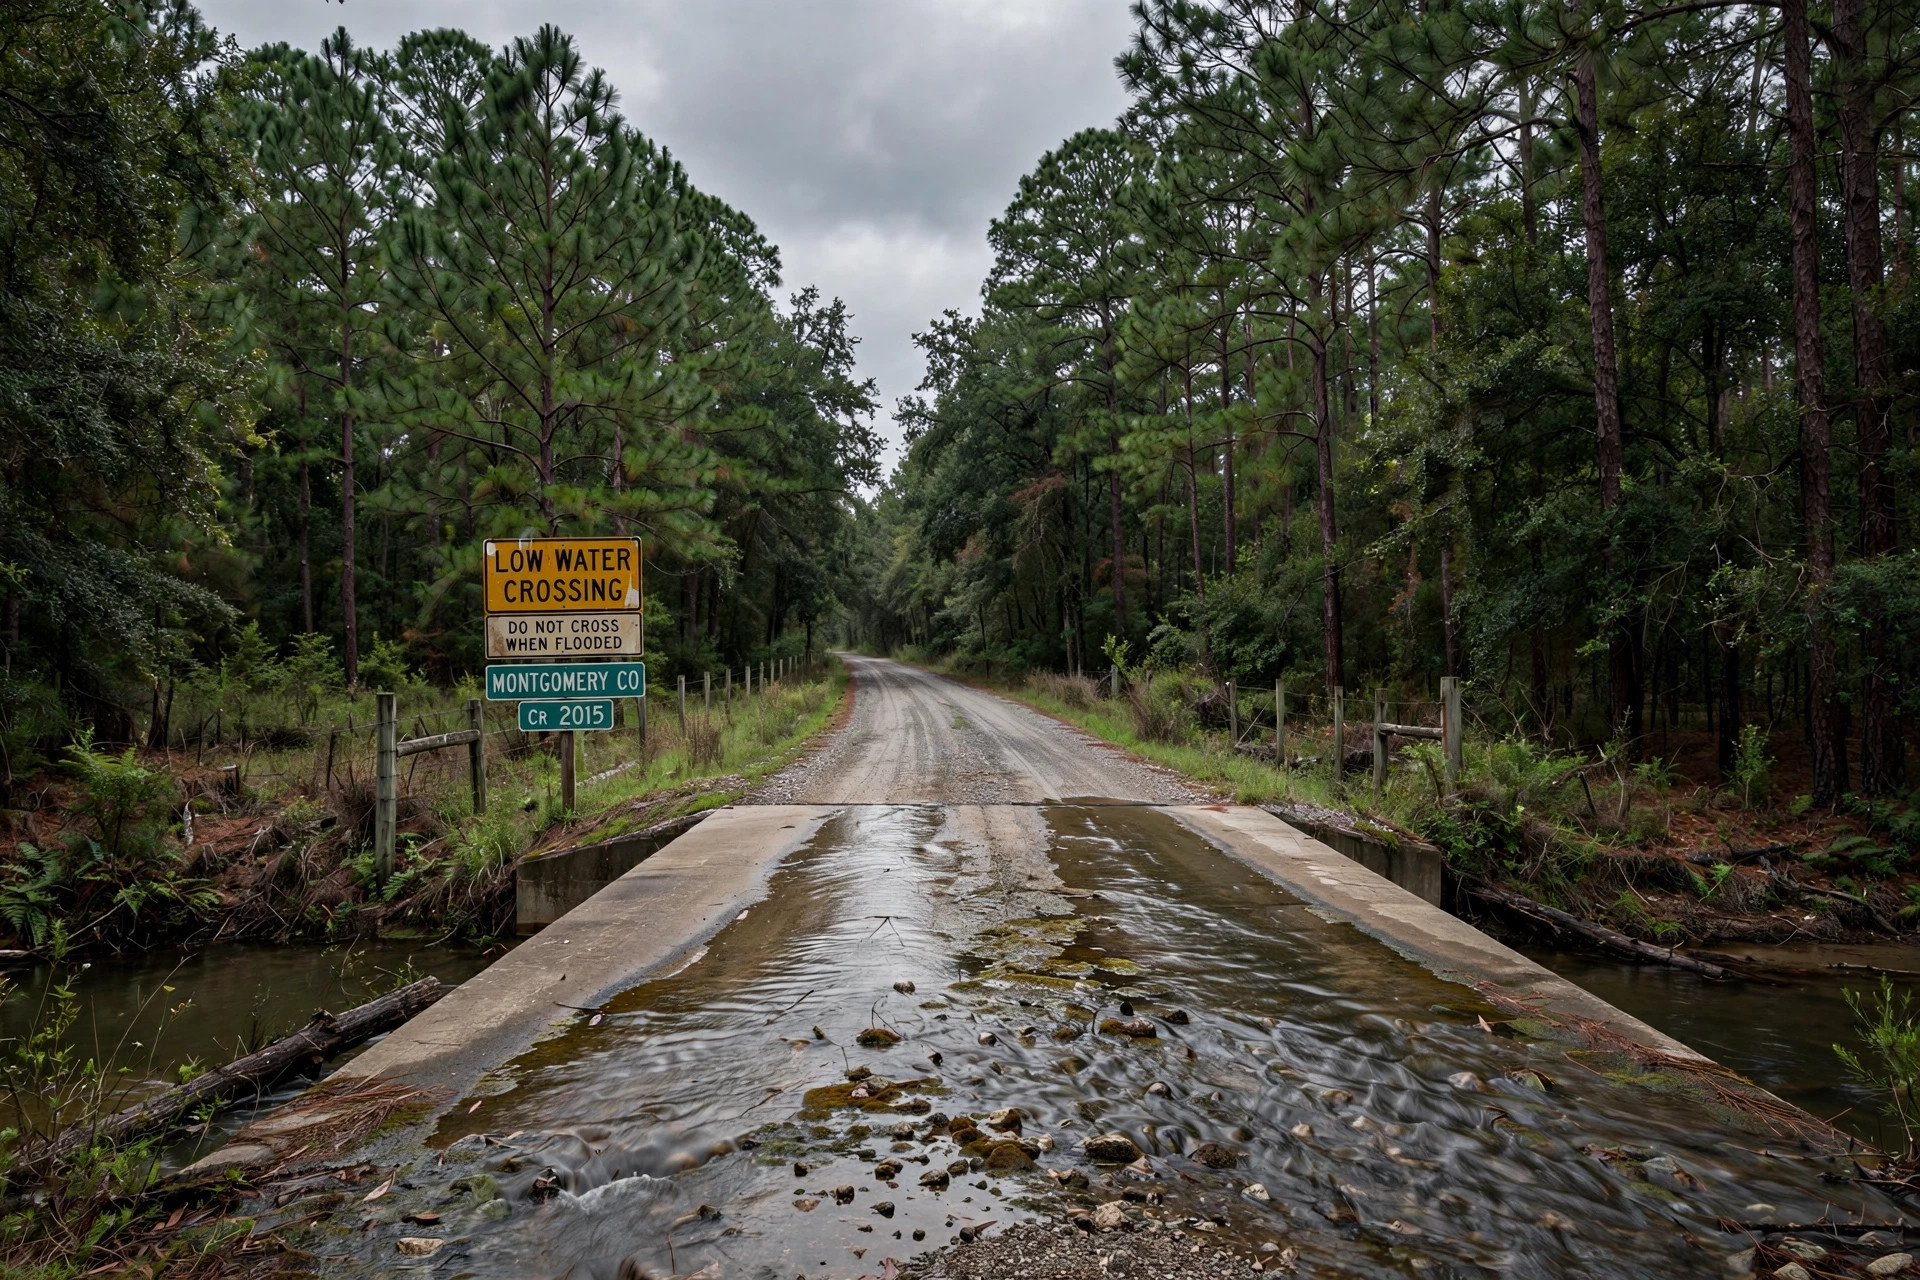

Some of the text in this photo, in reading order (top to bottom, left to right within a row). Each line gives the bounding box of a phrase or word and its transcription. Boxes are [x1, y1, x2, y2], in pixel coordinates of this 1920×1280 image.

[495, 548, 631, 573] LOW WATER
[504, 578, 622, 603] CROSSING
[508, 619, 619, 634] DO NOT CROSS
[506, 636, 622, 651] WHEN FLOODED
[492, 670, 639, 693] MONTGOMERY CO
[528, 705, 604, 726] CR 2015
